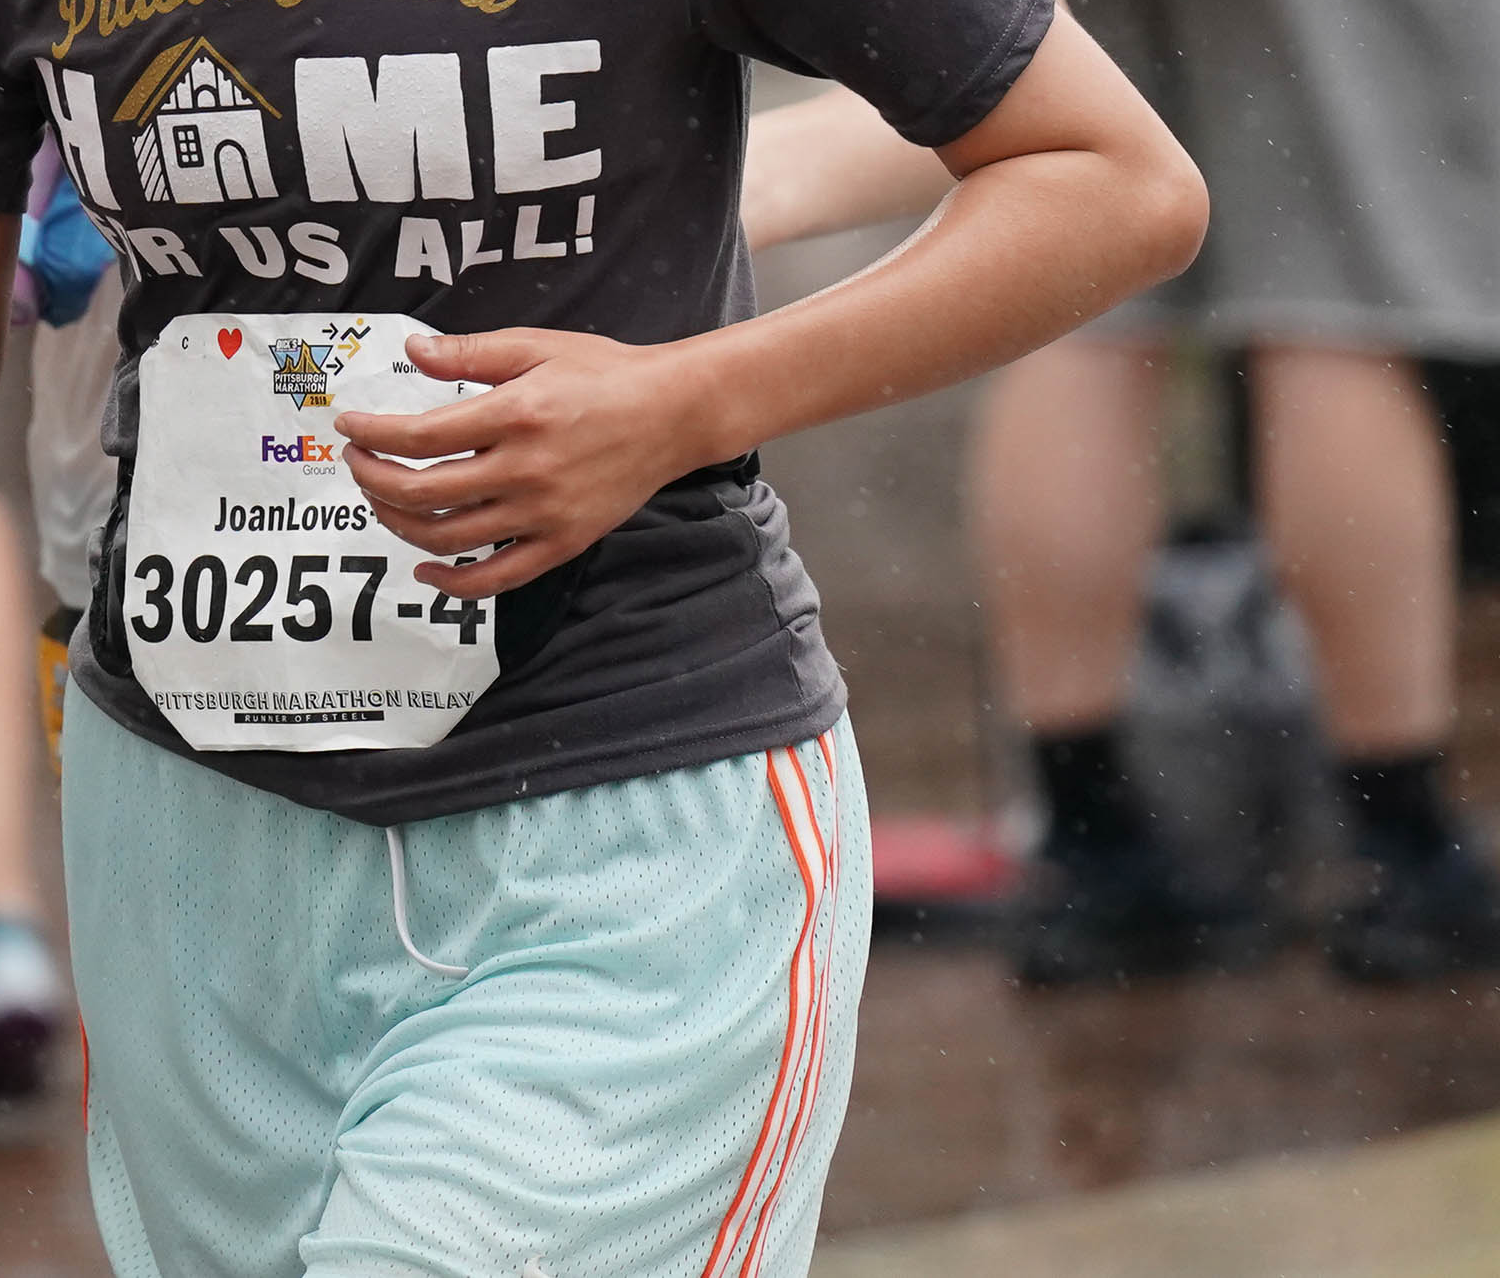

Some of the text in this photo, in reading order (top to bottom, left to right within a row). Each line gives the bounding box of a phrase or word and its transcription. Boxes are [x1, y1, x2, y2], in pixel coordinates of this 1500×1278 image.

[220, 222, 348, 285] US
[394, 194, 596, 287] ALL!
[275, 374, 326, 383] PITTSBURGH
[275, 383, 325, 394] MARATHON
[457, 382, 466, 395] F
[261, 435, 334, 463] FedEx
[302, 465, 336, 476] Ground
[214, 497, 376, 532] JoanLoves
[130, 554, 488, 645] 30257-4
[155, 689, 475, 710] PITTSBURGH MARATHON RELAY
[244, 713, 368, 723] RUNNER OF STEEL
